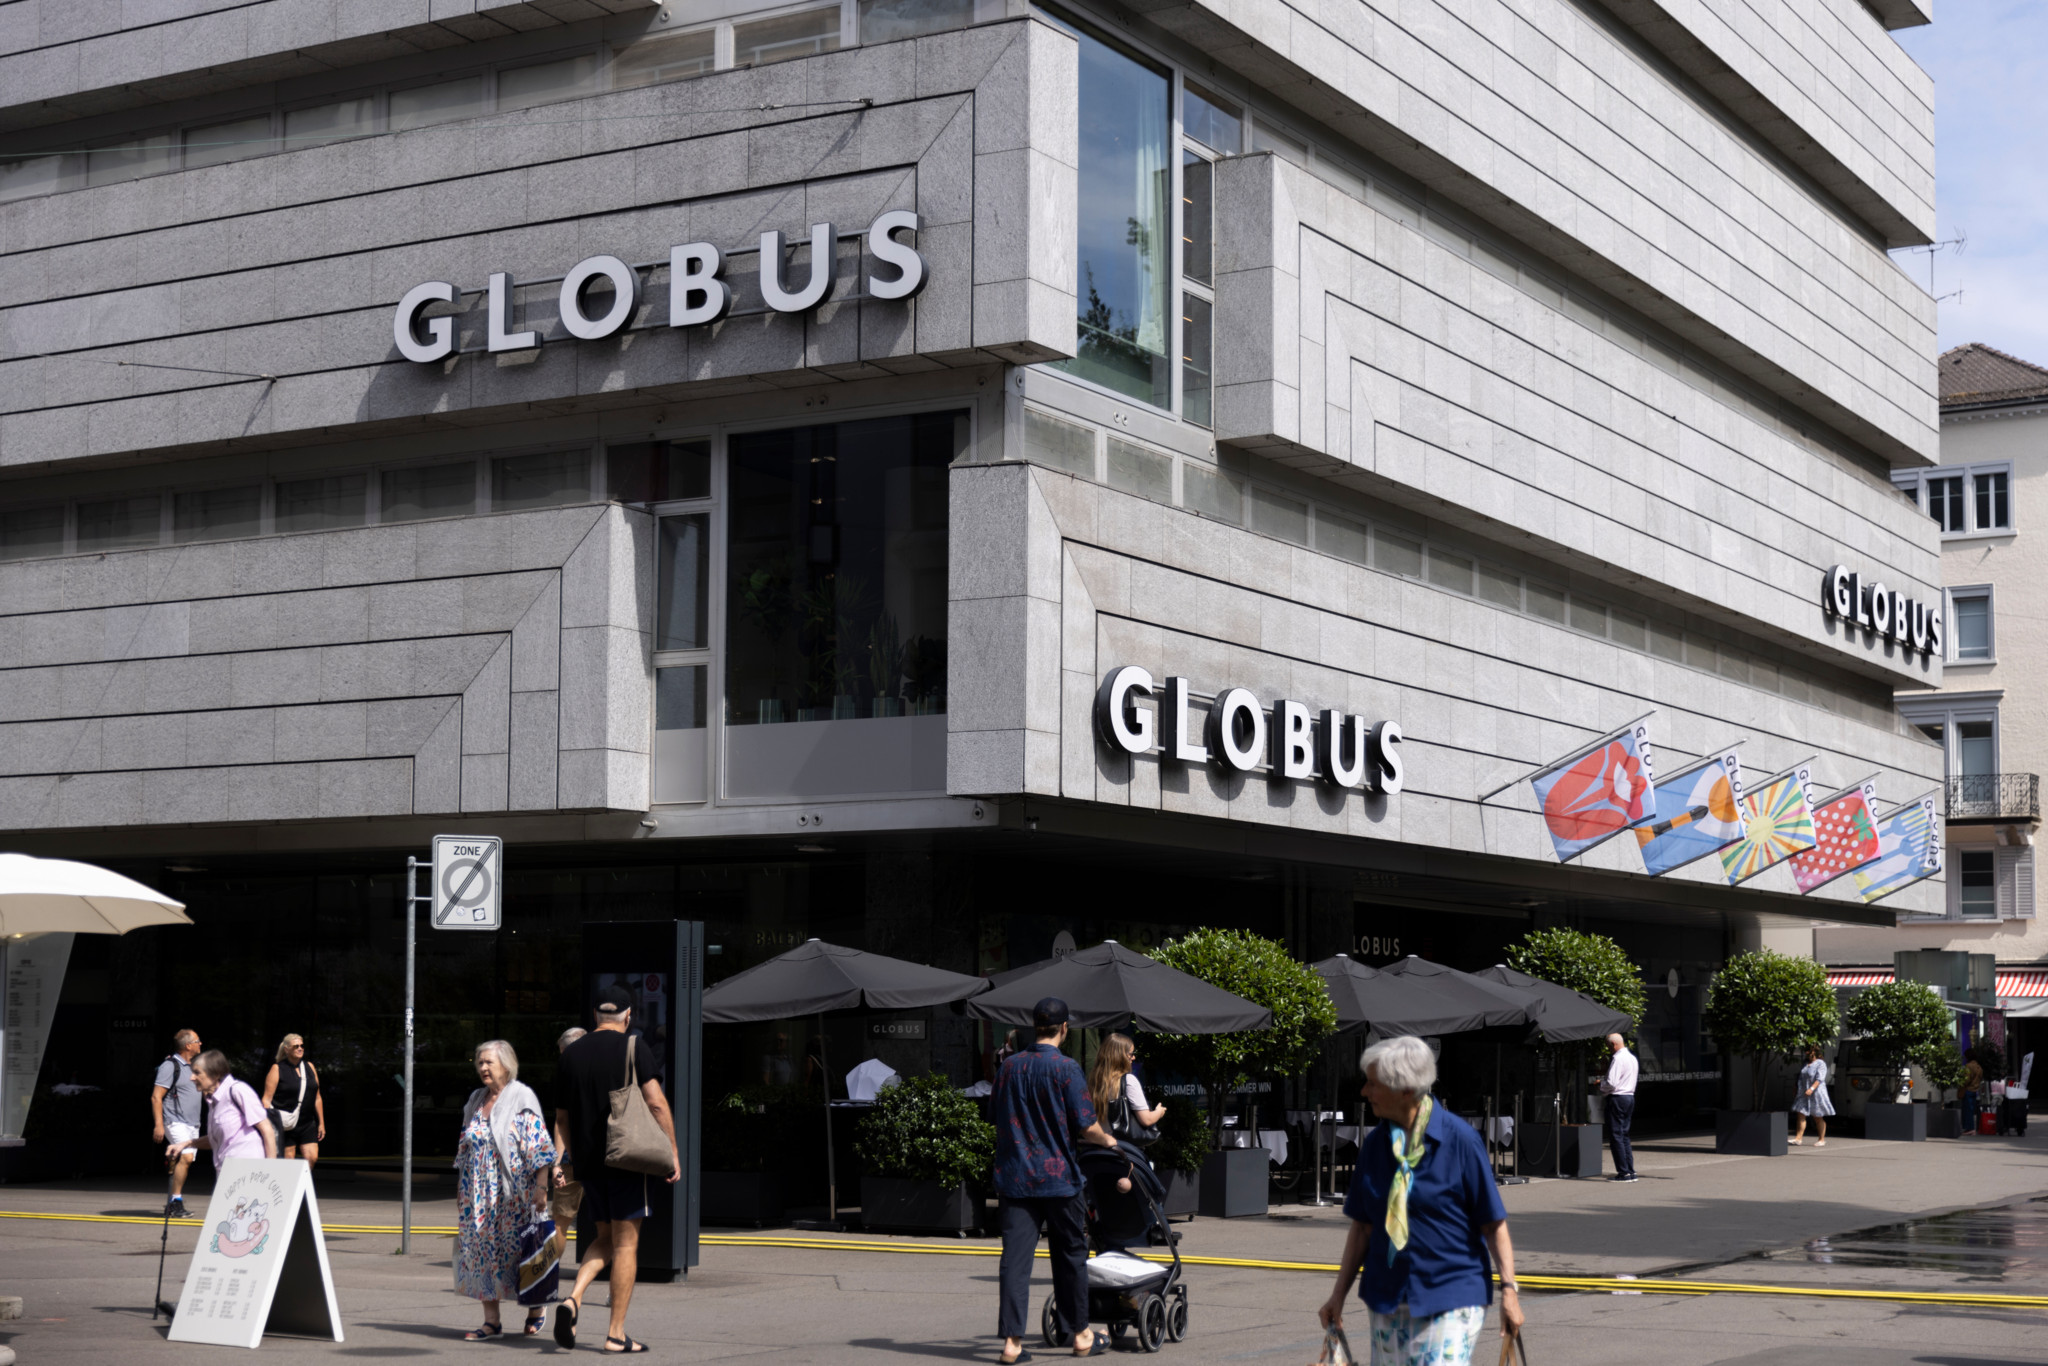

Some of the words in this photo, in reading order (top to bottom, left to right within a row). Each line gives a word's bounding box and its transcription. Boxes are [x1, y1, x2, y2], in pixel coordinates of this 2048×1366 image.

[394, 209, 928, 363] GLOBUS
[1826, 564, 1942, 656] GLOBUS
[1100, 665, 1403, 795] GLOBUS
[1636, 726, 1654, 782] GLO
[1800, 769, 1815, 818] GLO
[453, 845, 482, 856] ZONE
[1353, 935, 1400, 957] LOBUS
[873, 1024, 921, 1034] GLOBUS
[1163, 1084, 1196, 1097] SUMMER
[1258, 1081, 1272, 1093] WIN
